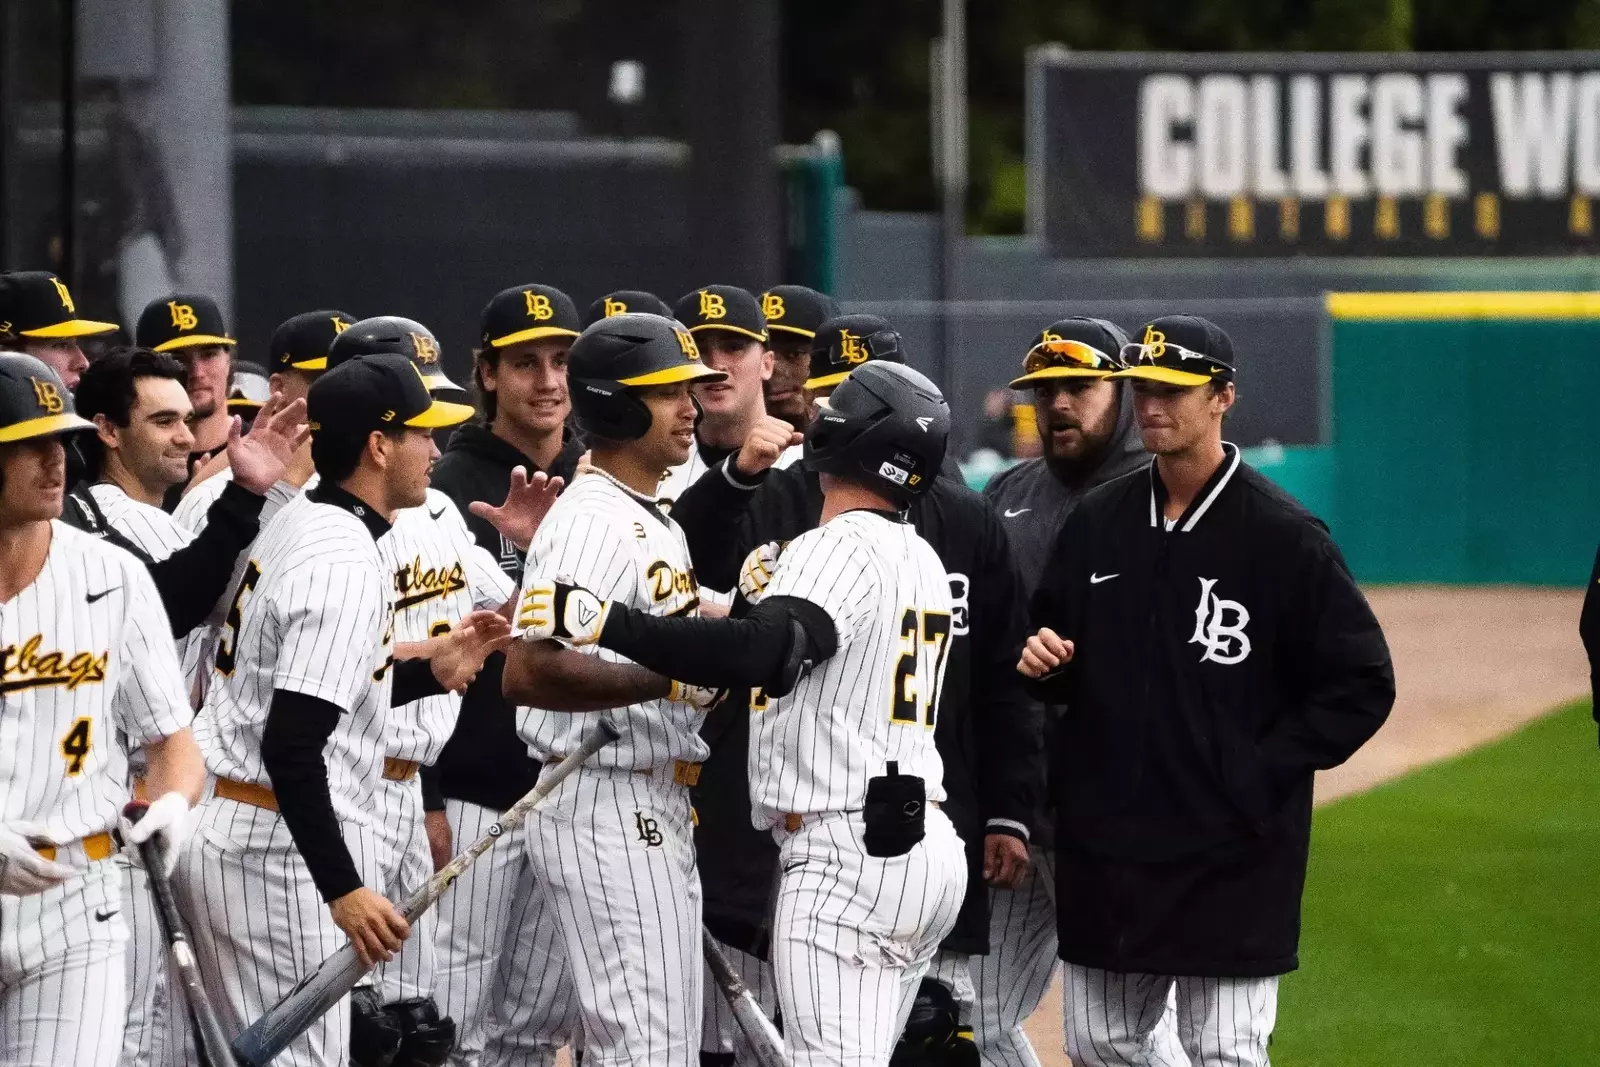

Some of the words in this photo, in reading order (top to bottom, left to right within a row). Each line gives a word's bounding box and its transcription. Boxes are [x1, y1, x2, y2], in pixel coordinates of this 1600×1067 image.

[1139, 73, 1469, 199] COLLEGE
[167, 300, 198, 332] LB
[523, 289, 554, 321] LB
[699, 289, 727, 320] LB
[762, 292, 786, 320] LB
[408, 331, 438, 365] LB
[673, 326, 700, 361] LB
[839, 329, 869, 364] LB
[1144, 325, 1166, 358] LB
[30, 376, 64, 413] LB
[1187, 576, 1252, 665] LB
[890, 604, 954, 731] 27
[59, 715, 94, 777] 4
[633, 810, 664, 849] LB
